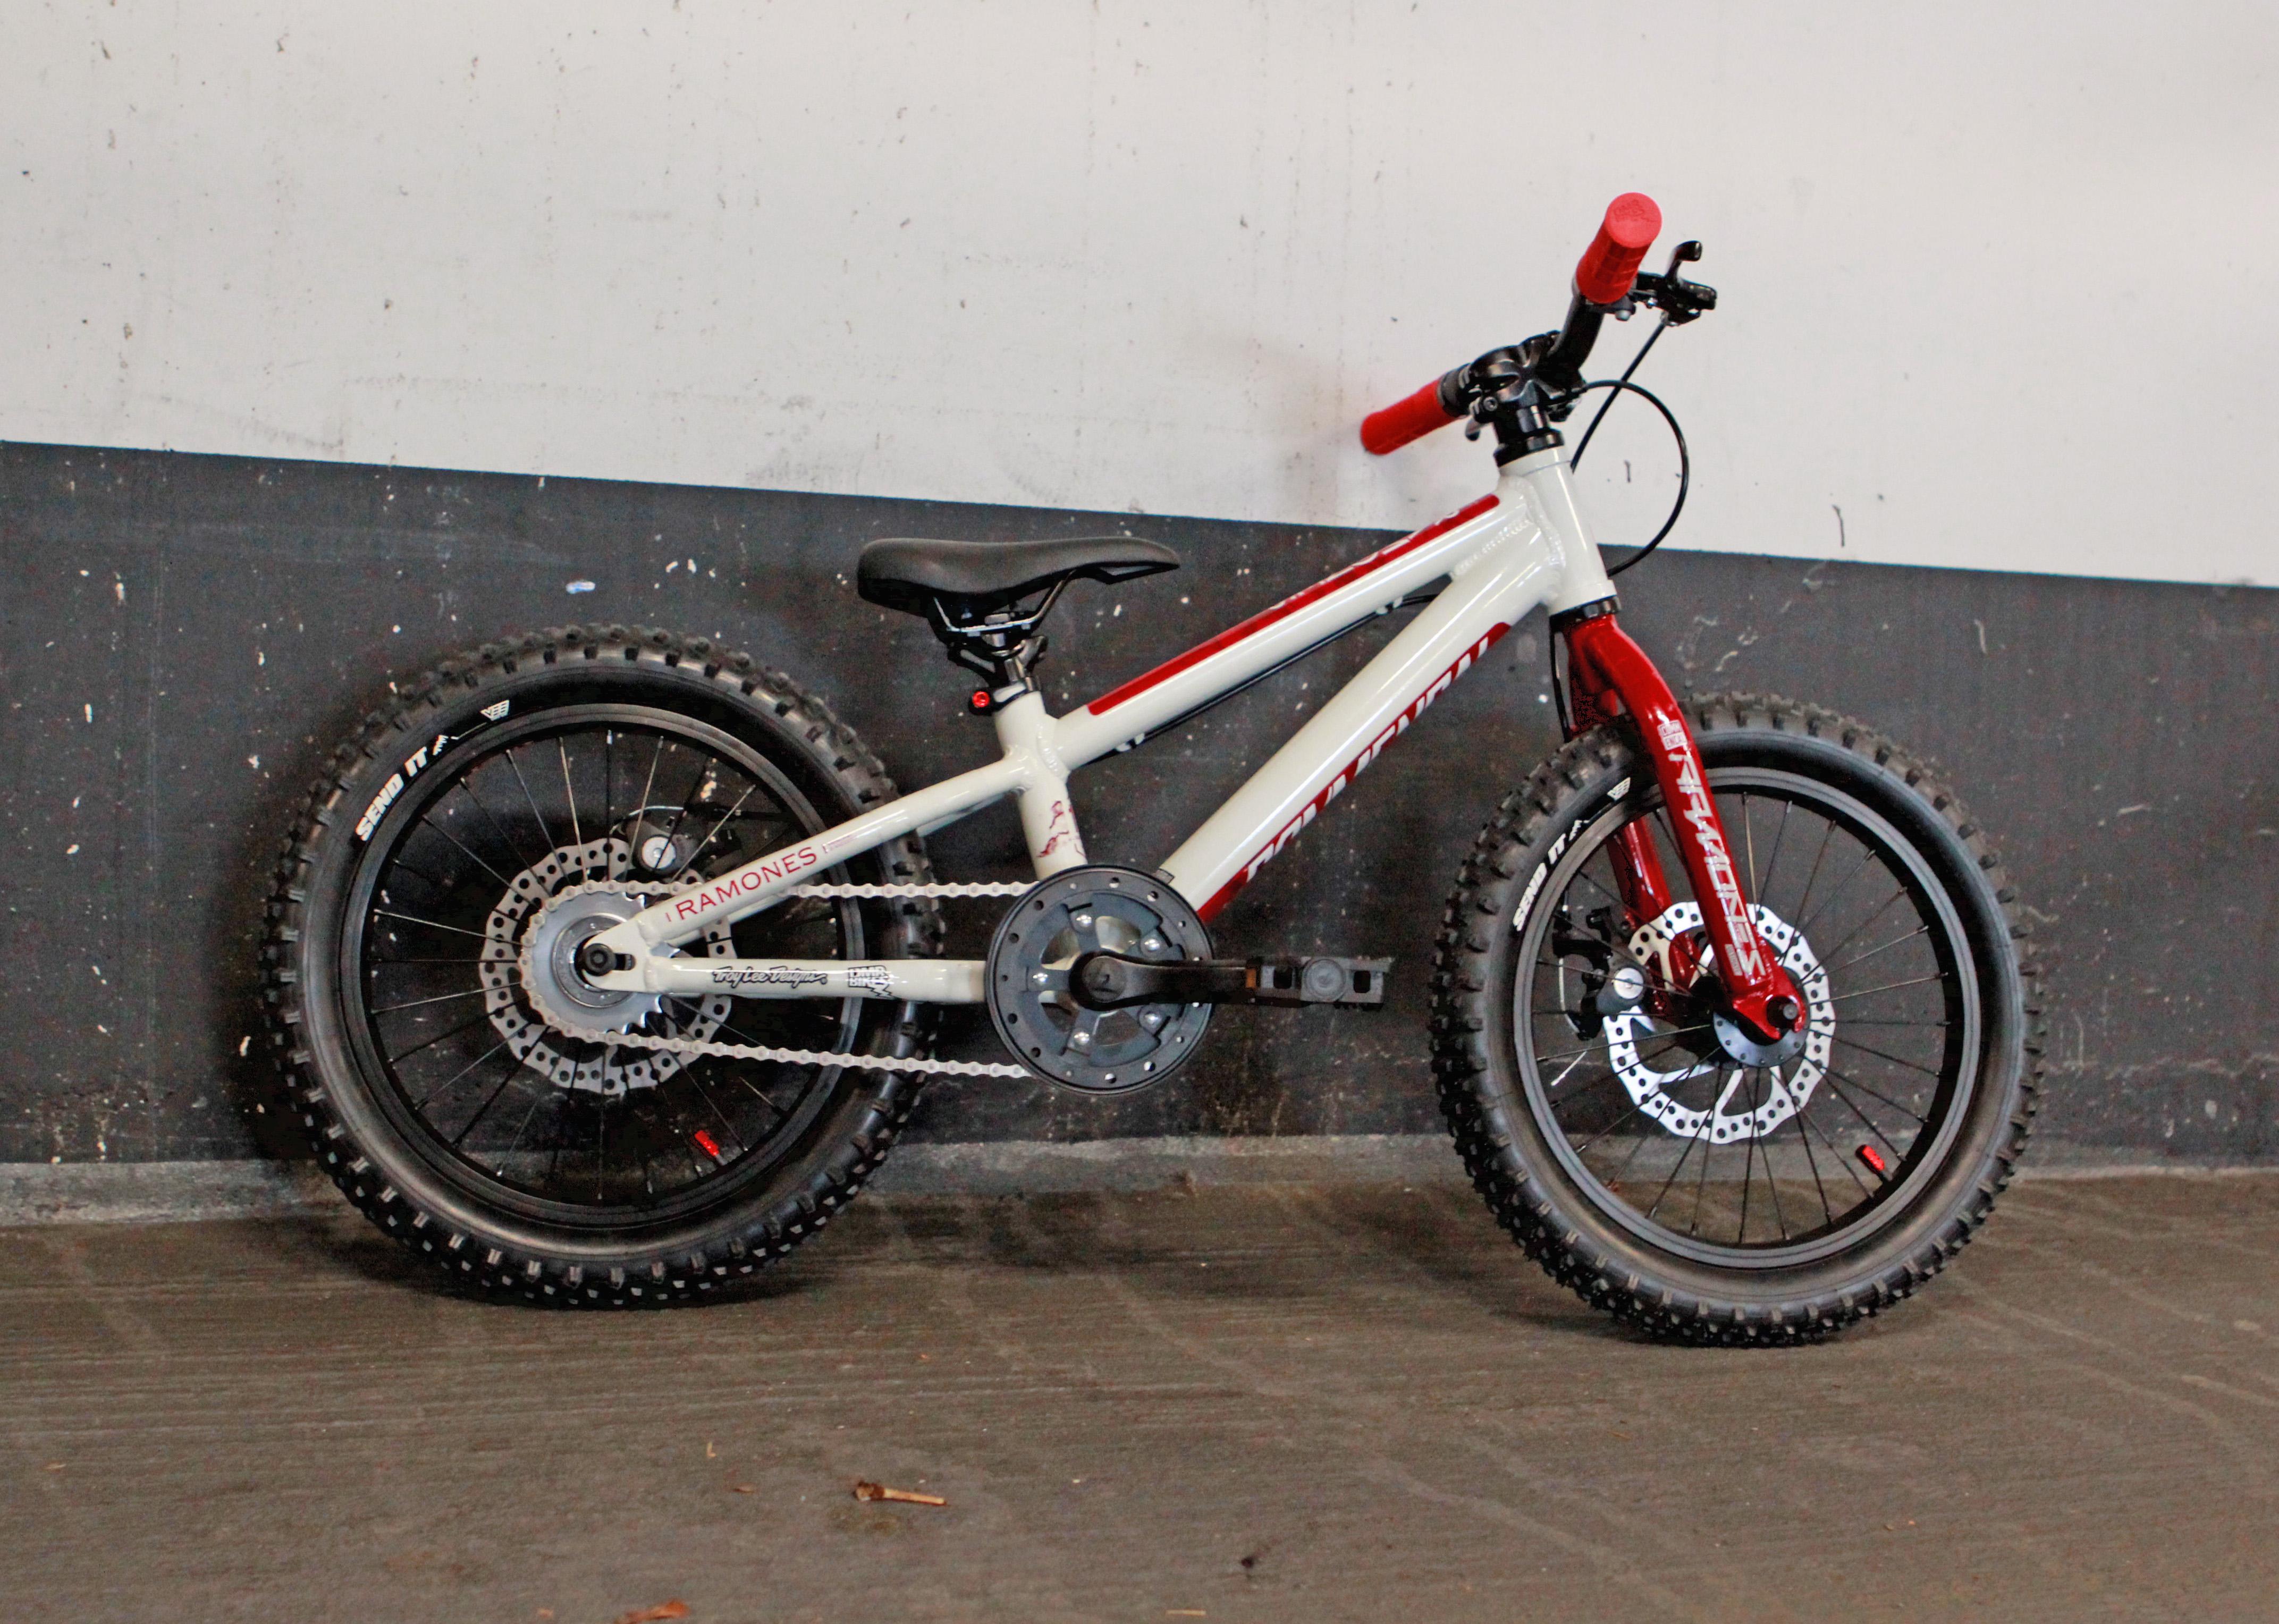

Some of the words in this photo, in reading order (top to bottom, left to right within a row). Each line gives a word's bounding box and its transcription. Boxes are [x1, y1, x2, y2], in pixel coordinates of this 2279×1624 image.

[355, 773, 404, 841] SEND
[404, 746, 427, 777] IT
[675, 847, 817, 920] RAMONES
[1513, 862, 1548, 931] SEND
[1548, 833, 1566, 865] IT
[1667, 752, 1767, 979] RAMONES
[712, 966, 743, 988] Troy
[742, 966, 769, 984] Lee
[848, 965, 887, 977] DMR
